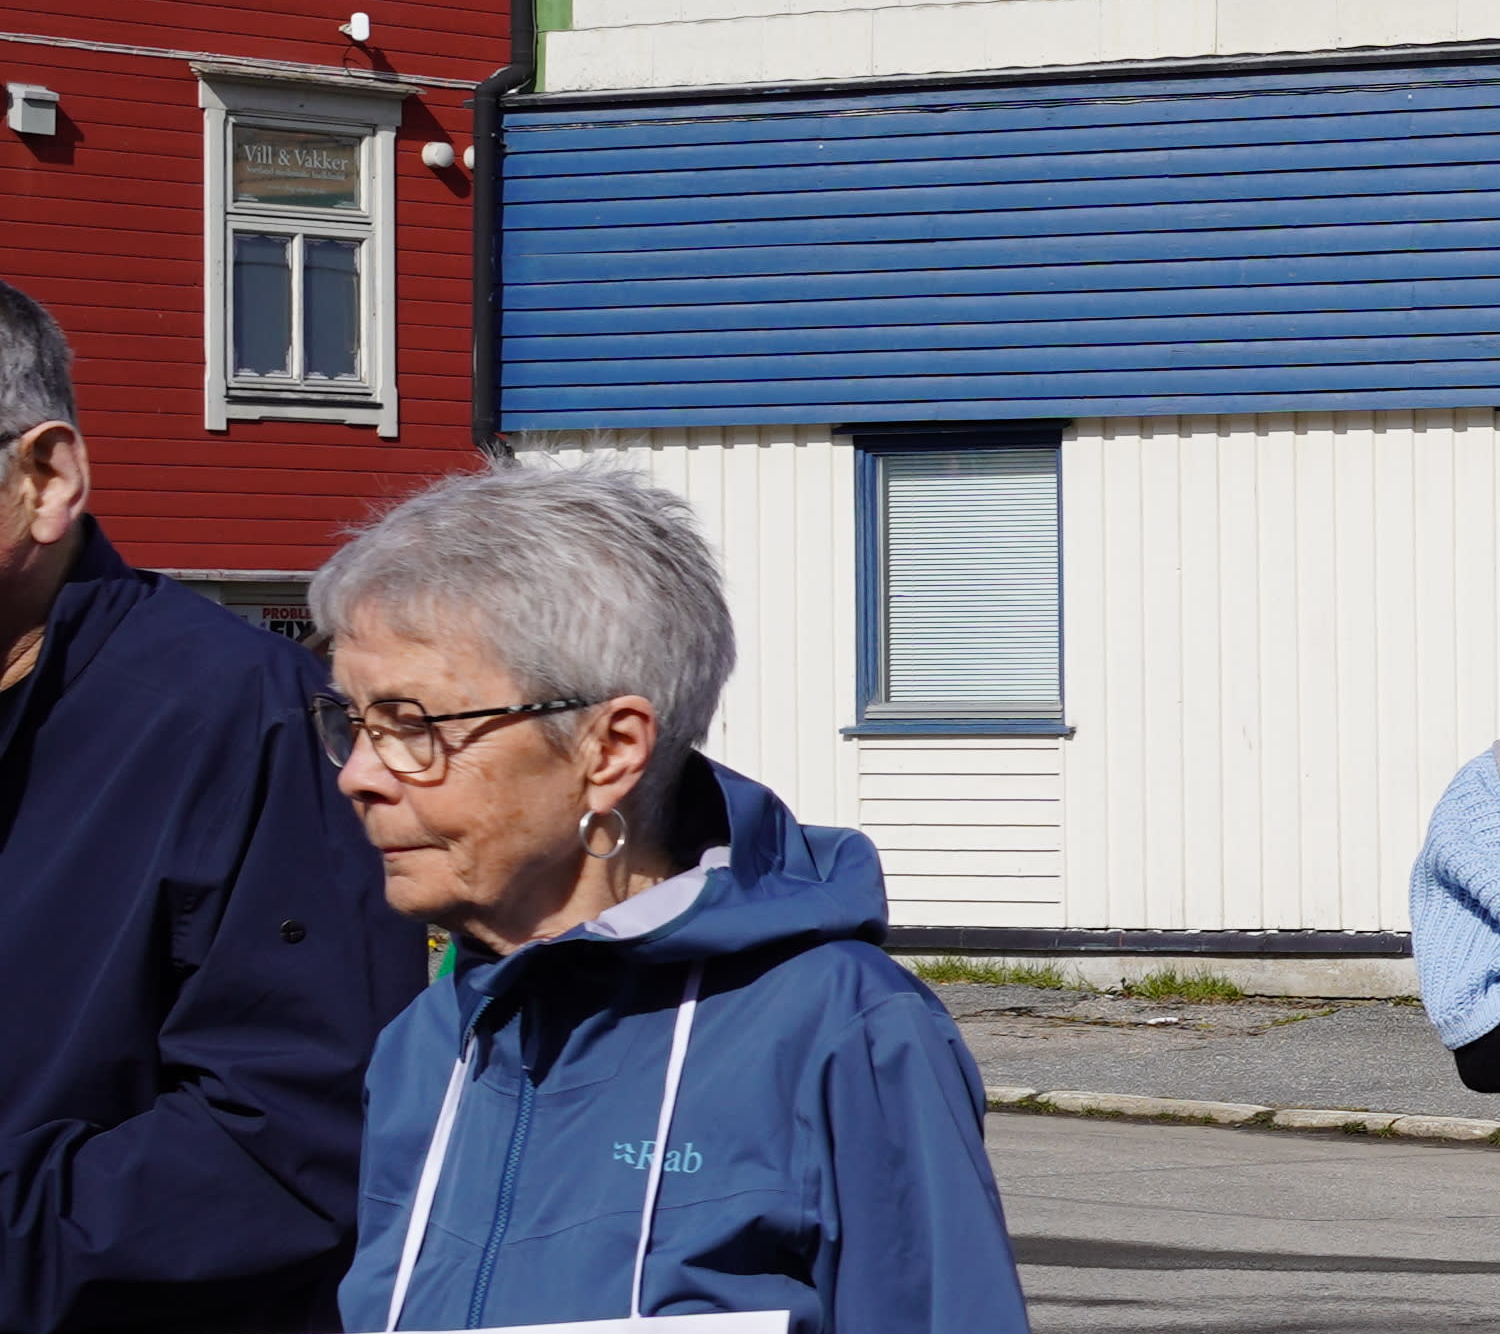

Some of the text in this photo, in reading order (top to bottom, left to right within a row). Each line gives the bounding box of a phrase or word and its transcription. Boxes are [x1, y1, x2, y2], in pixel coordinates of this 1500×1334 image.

[243, 144, 350, 172] Vill & Vakker
[262, 607, 314, 620] PROBLE
